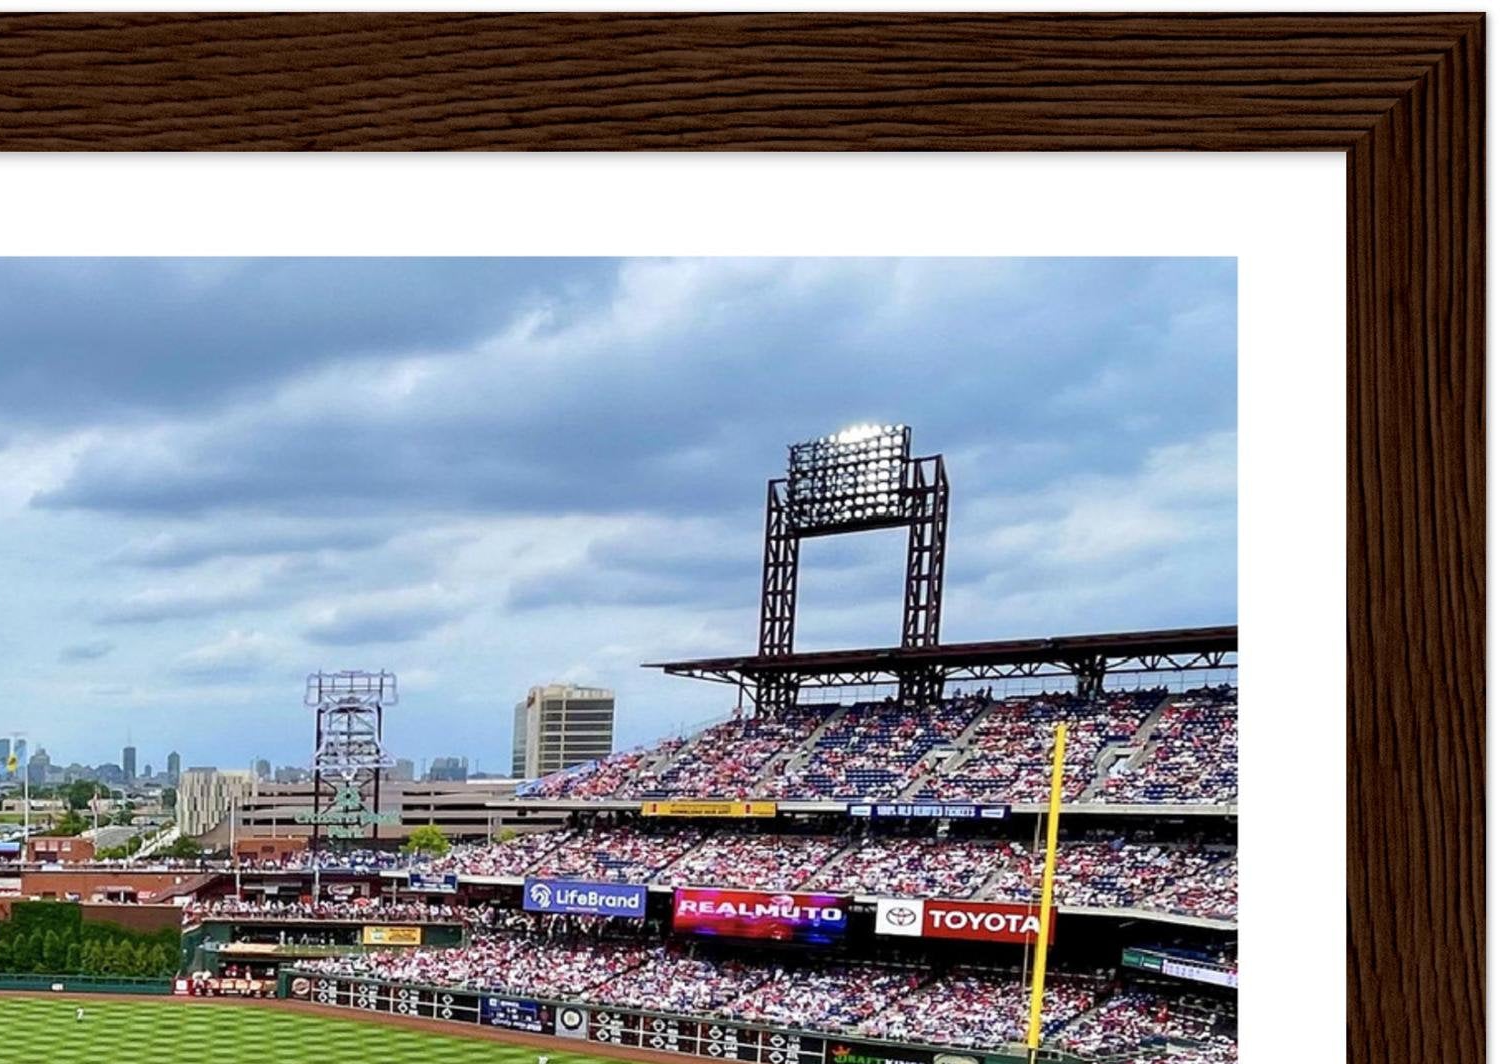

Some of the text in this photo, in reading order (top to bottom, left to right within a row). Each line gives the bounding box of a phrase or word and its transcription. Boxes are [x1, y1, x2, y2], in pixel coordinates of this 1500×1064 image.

[556, 889, 639, 908] LifeBrand
[679, 899, 842, 922] REALMUTO
[929, 910, 1041, 934] TOYOTA
